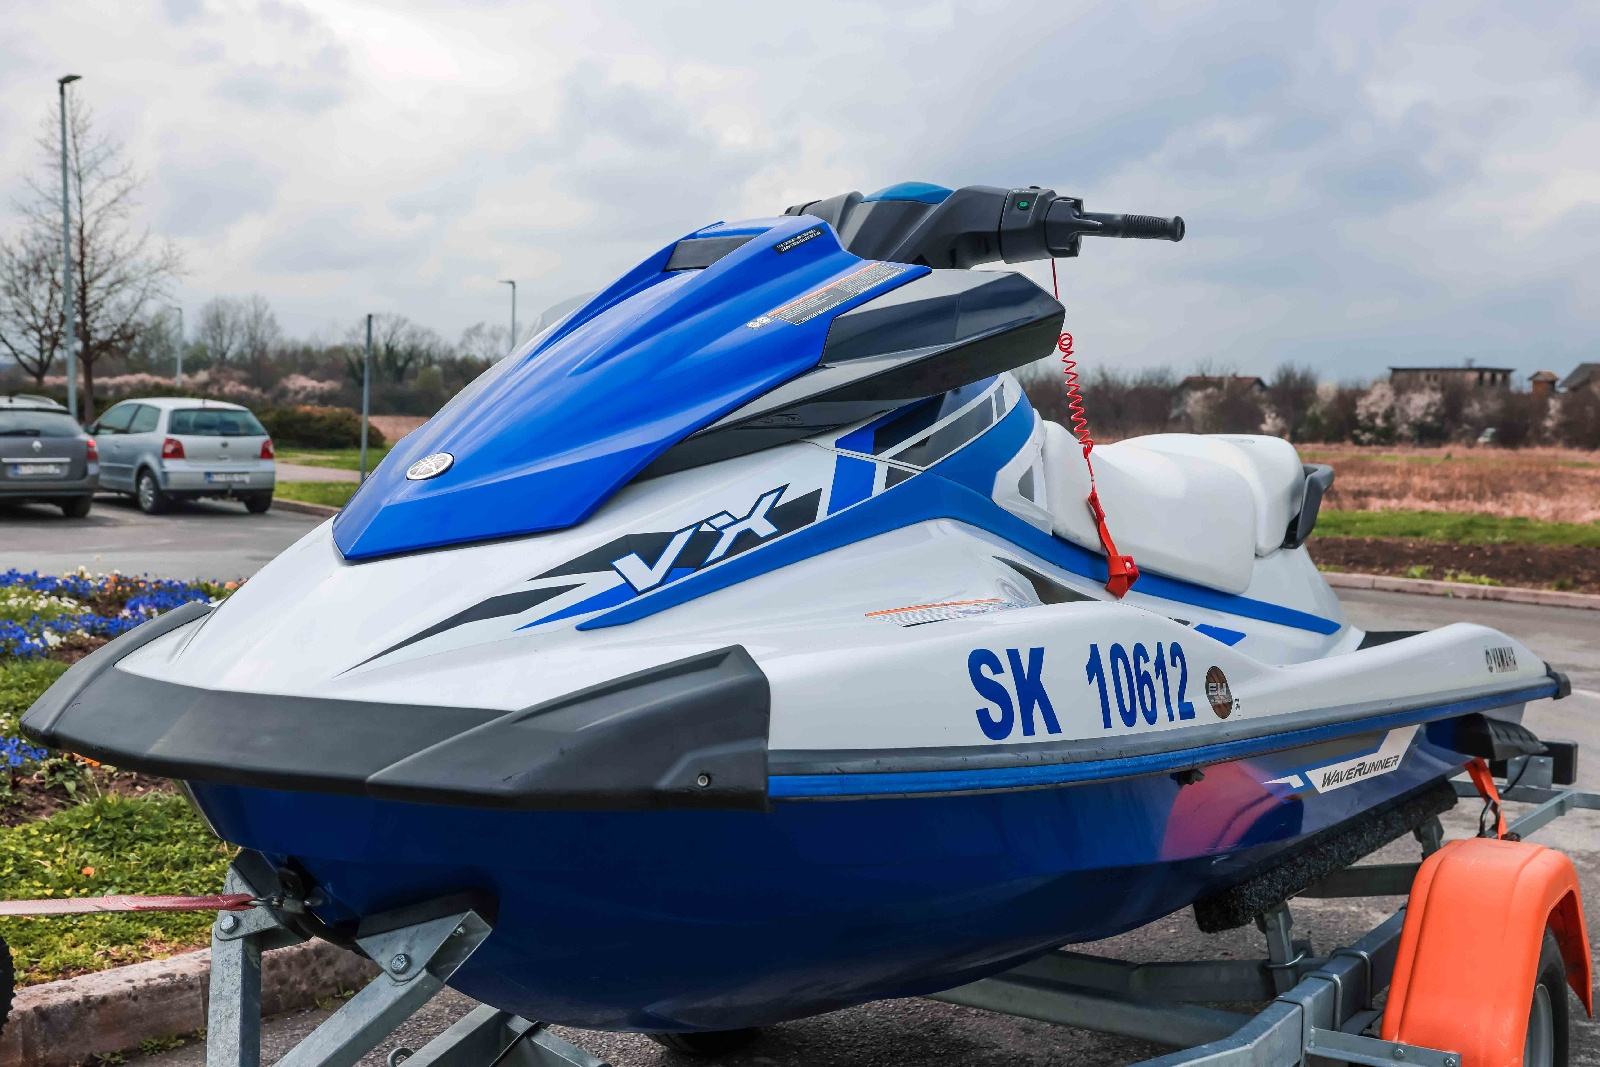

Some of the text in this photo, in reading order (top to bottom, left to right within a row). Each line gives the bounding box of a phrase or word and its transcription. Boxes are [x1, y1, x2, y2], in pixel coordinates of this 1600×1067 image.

[612, 484, 789, 595] VX
[967, 641, 1196, 740] SK 10612
[1321, 754, 1400, 788] WAVERUNNER
